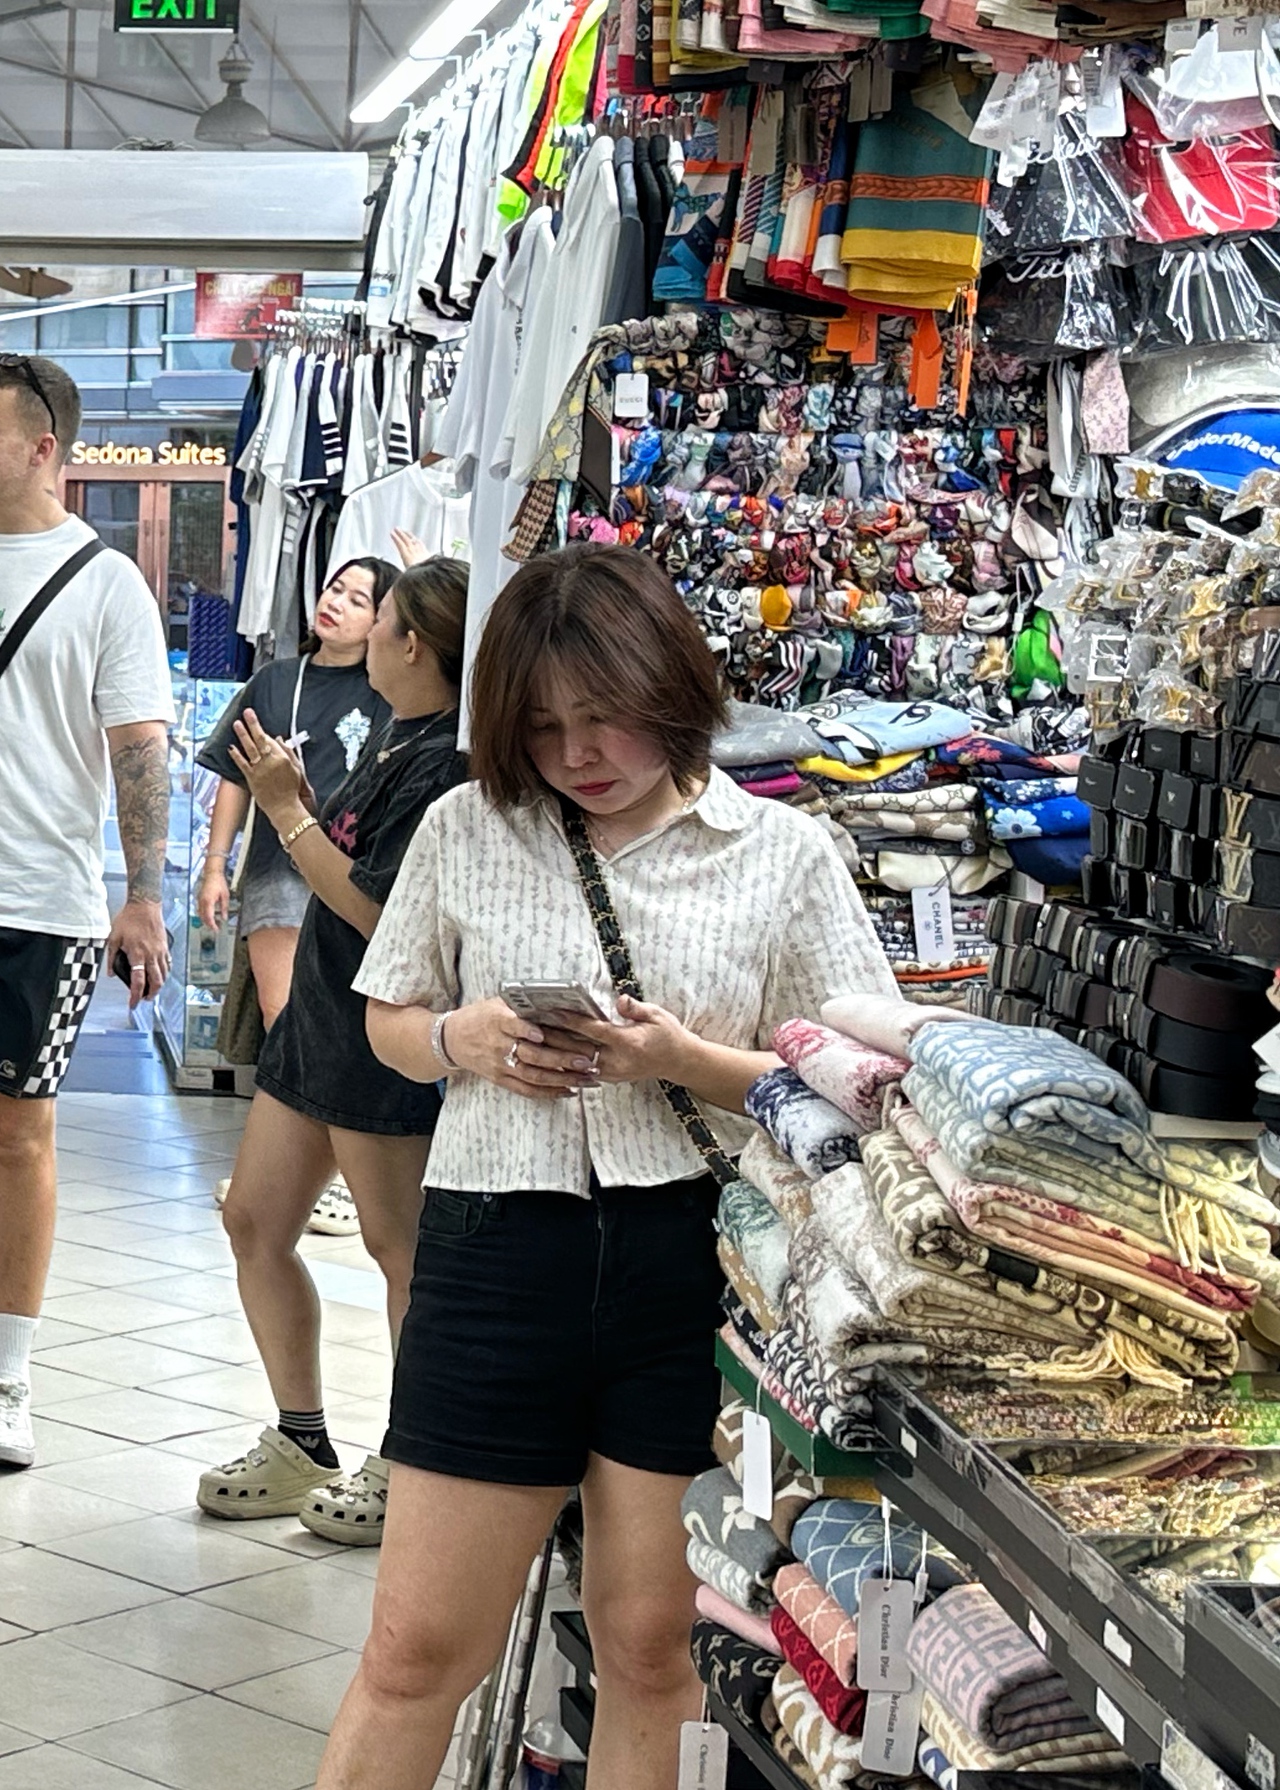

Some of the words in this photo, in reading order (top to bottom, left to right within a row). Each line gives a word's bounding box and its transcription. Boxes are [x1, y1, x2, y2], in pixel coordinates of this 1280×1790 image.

[71, 440, 153, 465] Sedona
[157, 440, 226, 466] Suites
[931, 901, 944, 949] CHANEL
[880, 1603, 892, 1651] Christian
[879, 1655, 890, 1679] Dior
[886, 1691, 900, 1733] hristian
[883, 1736, 895, 1761] Dior
